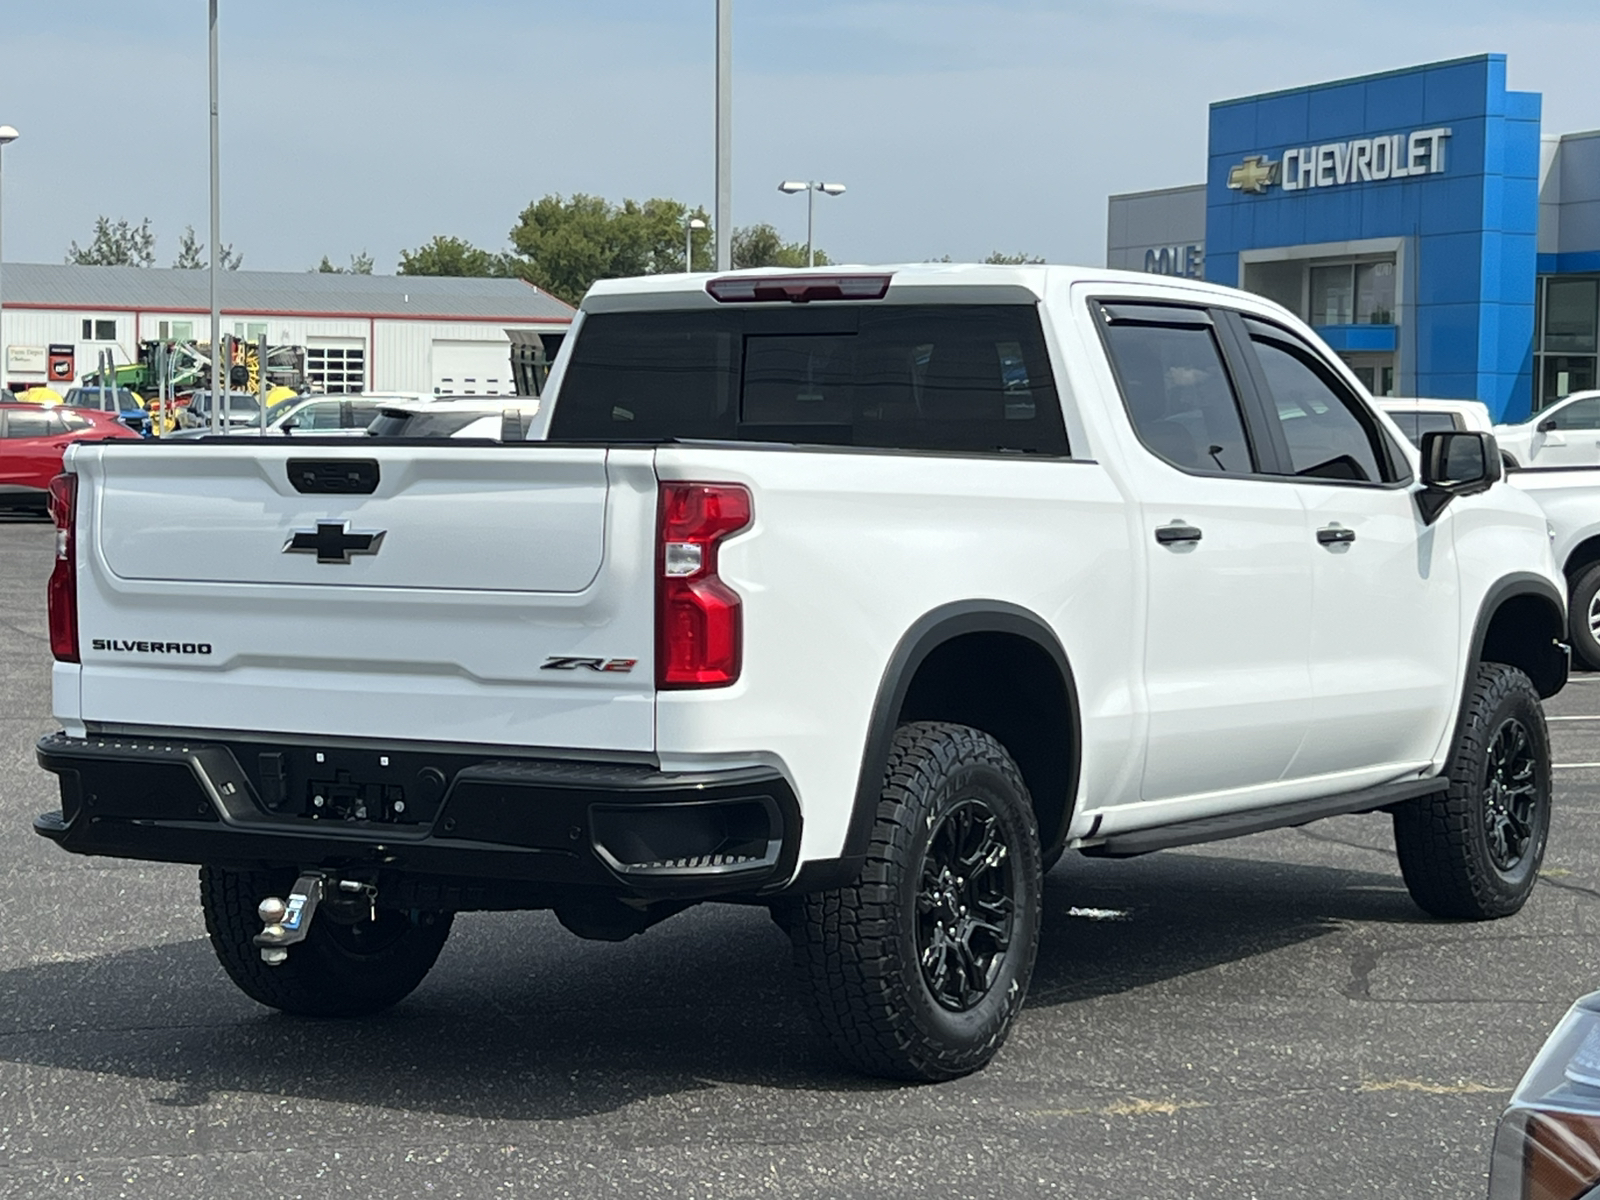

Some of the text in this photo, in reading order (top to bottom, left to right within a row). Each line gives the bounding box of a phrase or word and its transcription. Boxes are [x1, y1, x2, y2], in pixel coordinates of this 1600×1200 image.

[1282, 128, 1452, 191] CHEVROLET
[92, 639, 212, 654] SILVERADO
[539, 655, 638, 673] ZR2
